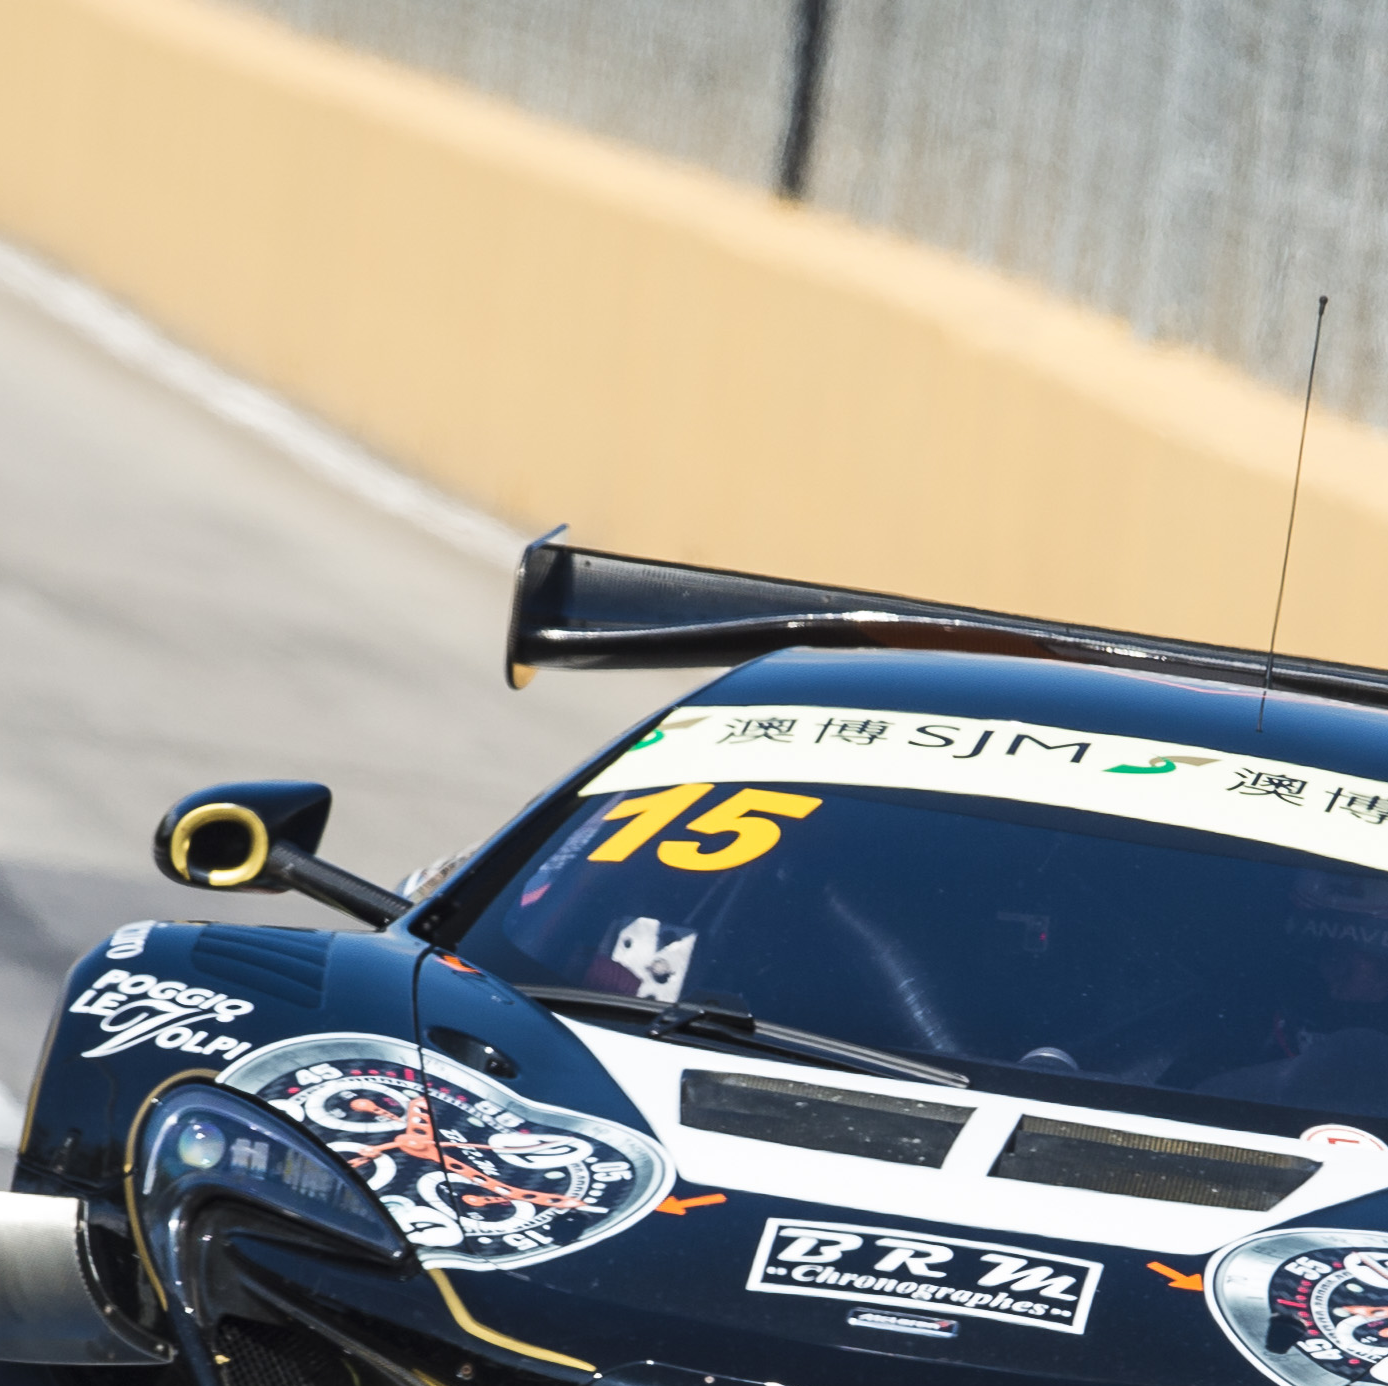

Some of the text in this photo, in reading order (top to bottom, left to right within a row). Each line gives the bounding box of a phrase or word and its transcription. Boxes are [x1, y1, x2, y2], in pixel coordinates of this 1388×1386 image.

[717, 717, 1092, 763] 澳博 SJM
[587, 783, 824, 872] 15
[68, 989, 129, 1017] LE
[91, 968, 255, 1017] POGGIO
[790, 1264, 1051, 1318] Chronographes
